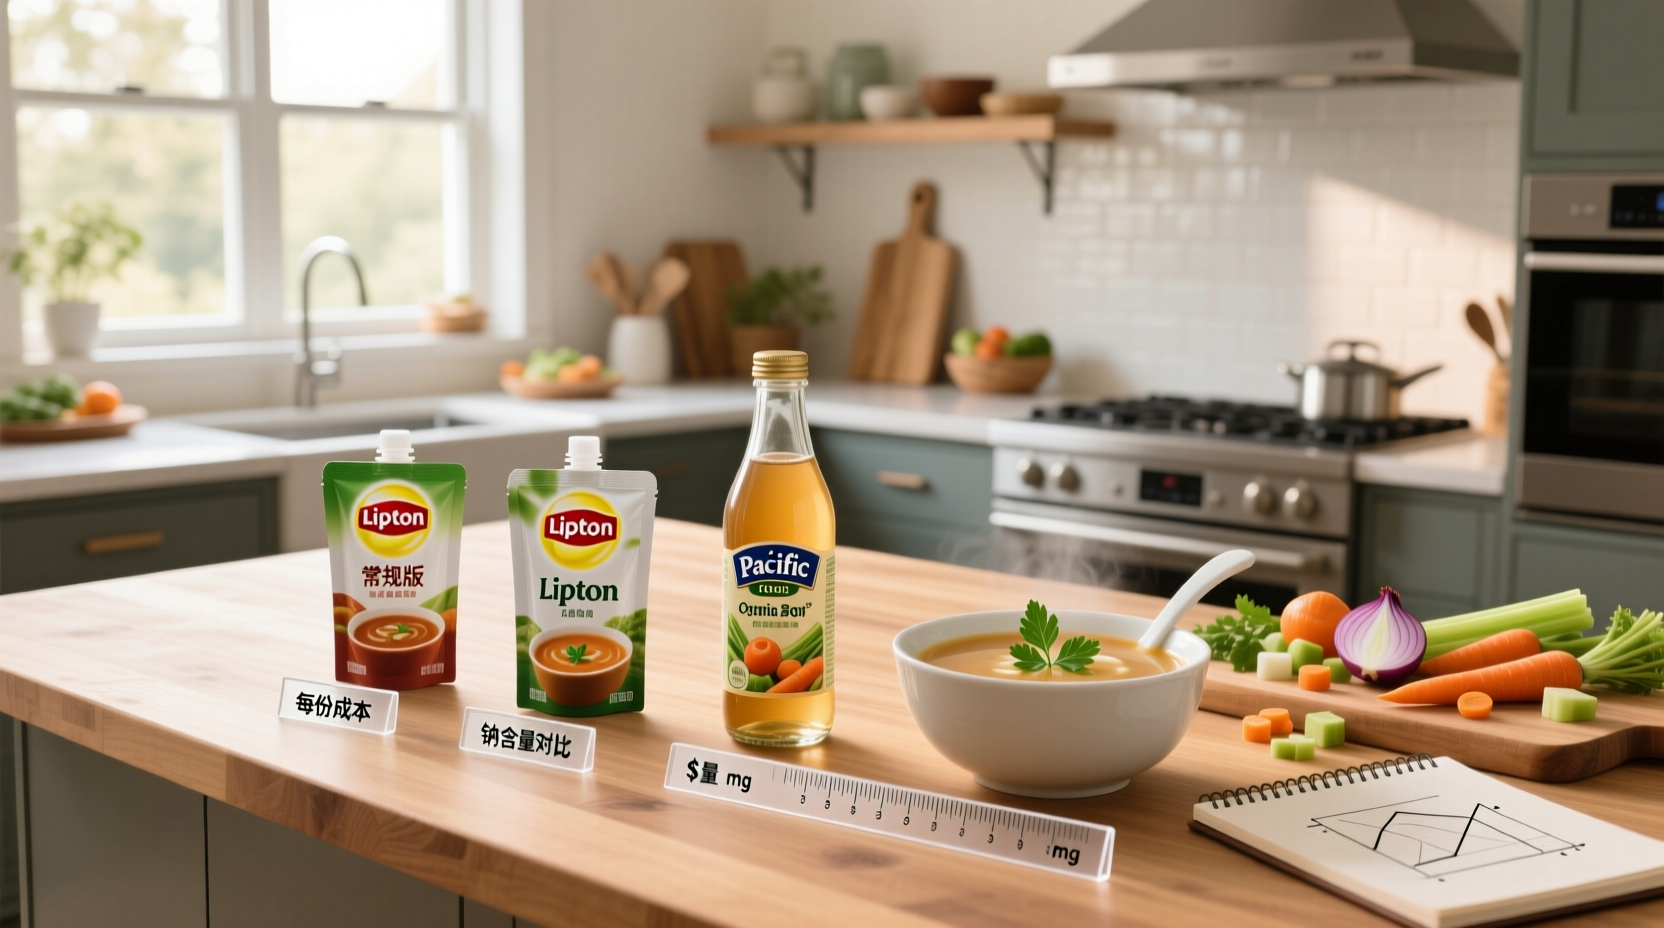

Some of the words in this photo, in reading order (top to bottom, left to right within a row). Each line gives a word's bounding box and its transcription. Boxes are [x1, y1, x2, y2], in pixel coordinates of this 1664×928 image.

[362, 507, 425, 530] Lipton
[549, 516, 613, 540] Lipton
[361, 564, 425, 588] 常规版
[539, 576, 619, 607] Lipton
[295, 691, 372, 723] 每份成本
[480, 721, 573, 759] 钠含量对比
[726, 771, 752, 793] mg
[1052, 844, 1080, 867] mg
